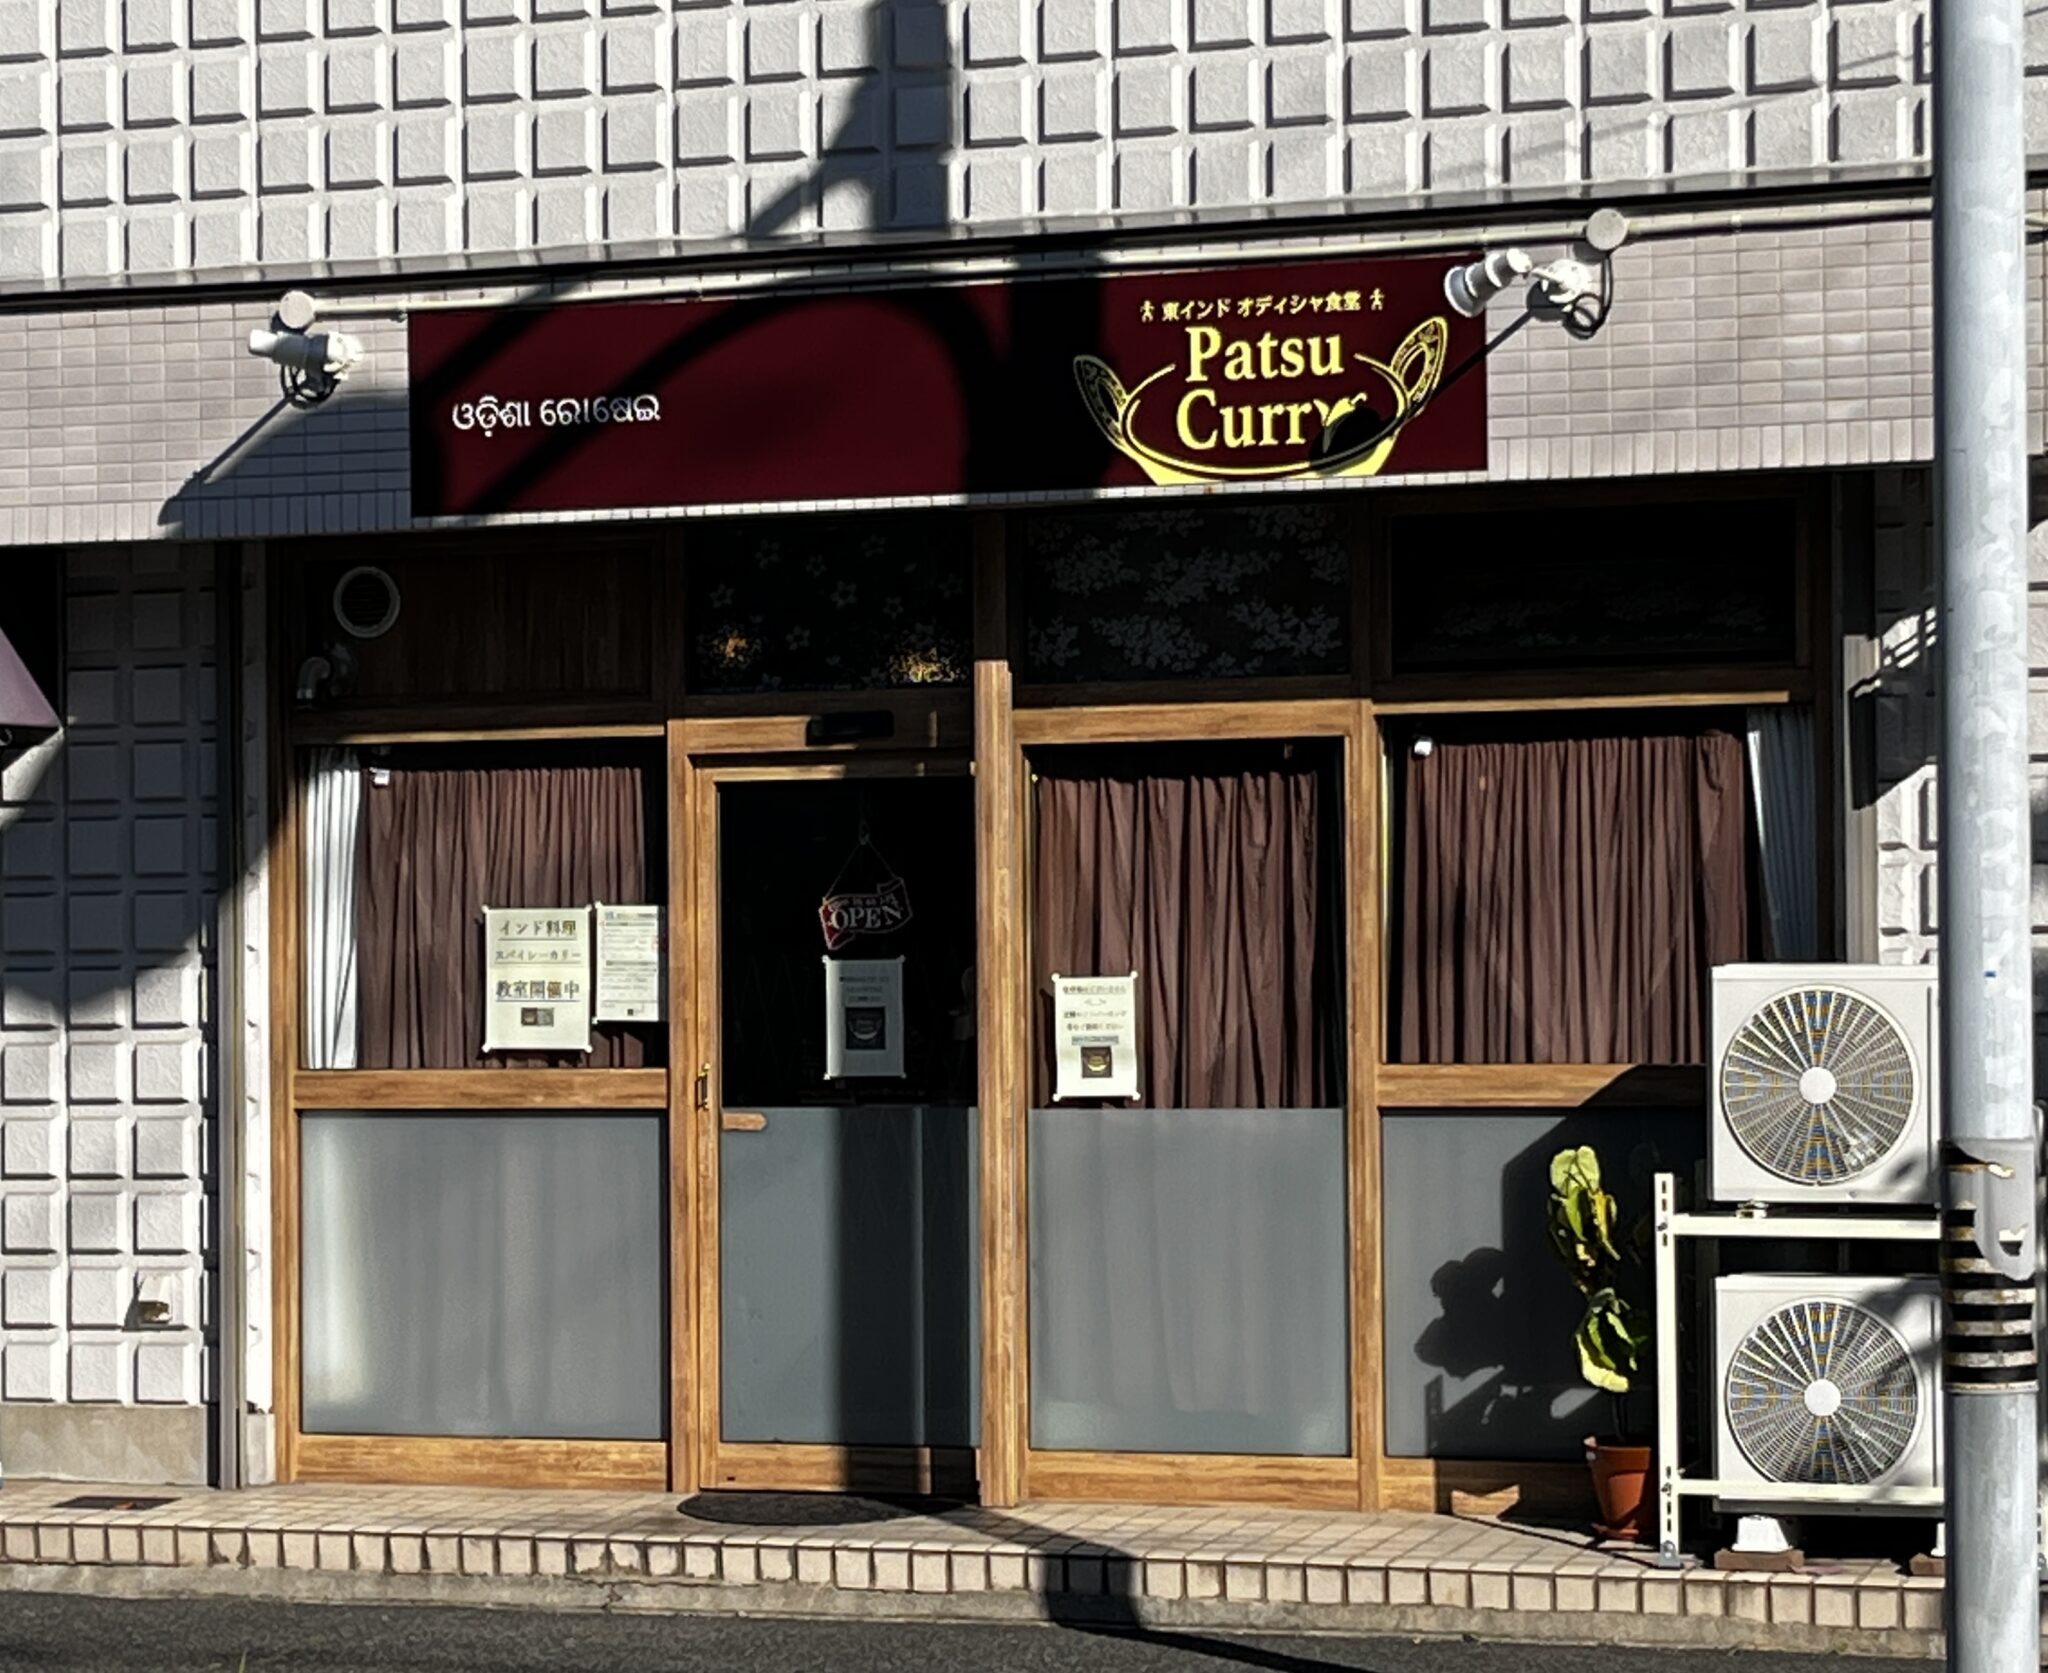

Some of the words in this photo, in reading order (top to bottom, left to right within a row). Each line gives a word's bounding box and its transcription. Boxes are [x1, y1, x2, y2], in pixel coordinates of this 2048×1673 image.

[1162, 298, 1231, 322] 東インド
[1237, 290, 1362, 318] オディシャ食堂
[1184, 325, 1345, 383] Patsu
[1175, 388, 1367, 453] Curry
[499, 919, 577, 936] インド料理
[830, 905, 902, 929] OPEN
[495, 979, 580, 999] 教室開催中
